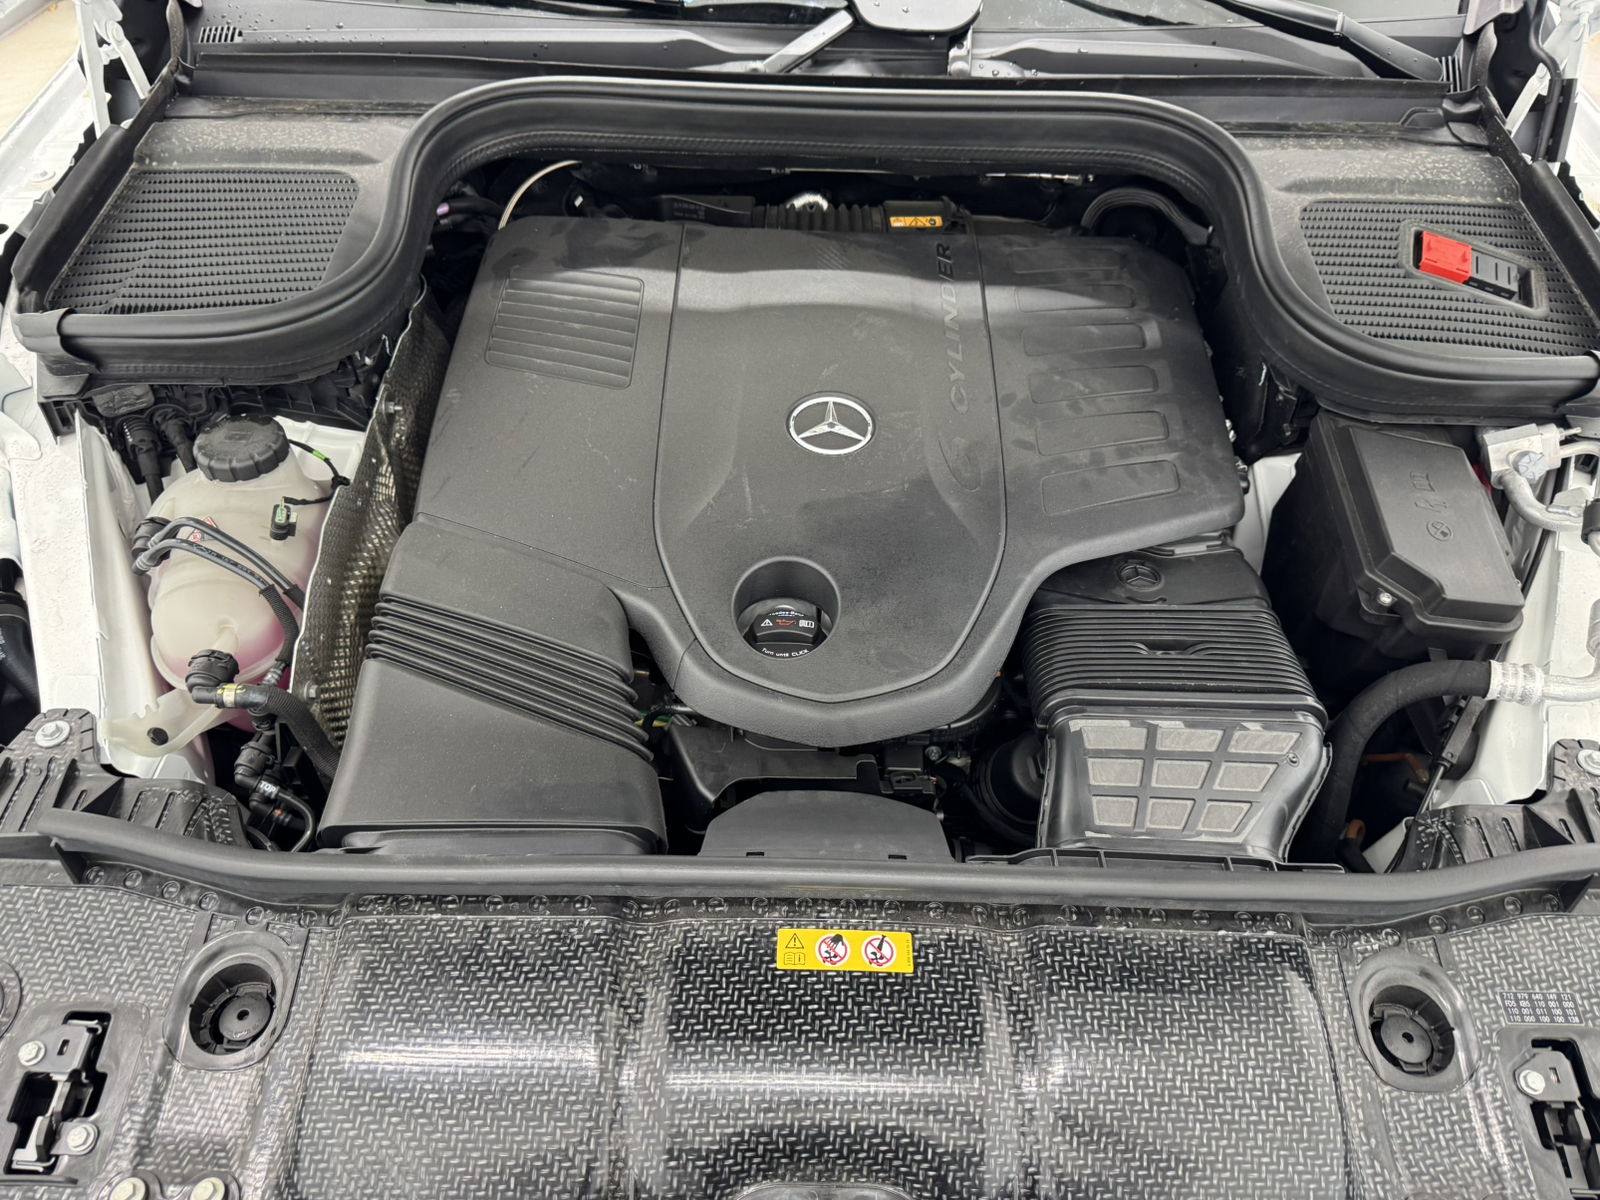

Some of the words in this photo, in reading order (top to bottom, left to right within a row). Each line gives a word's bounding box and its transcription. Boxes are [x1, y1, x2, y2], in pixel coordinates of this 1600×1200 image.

[937, 242, 969, 415] CYLINDER
[761, 647, 775, 656] Turn
[791, 648, 810, 657] CLICK
[260, 780, 277, 793] TOP
[1502, 992, 1514, 1000] 712
[1516, 992, 1529, 1000] 979
[1546, 993, 1558, 1001] 149
[1560, 993, 1572, 1001] 121
[1534, 1000, 1546, 1008] 110
[1565, 1008, 1577, 1016] 101
[1538, 1015, 1551, 1023] 100
